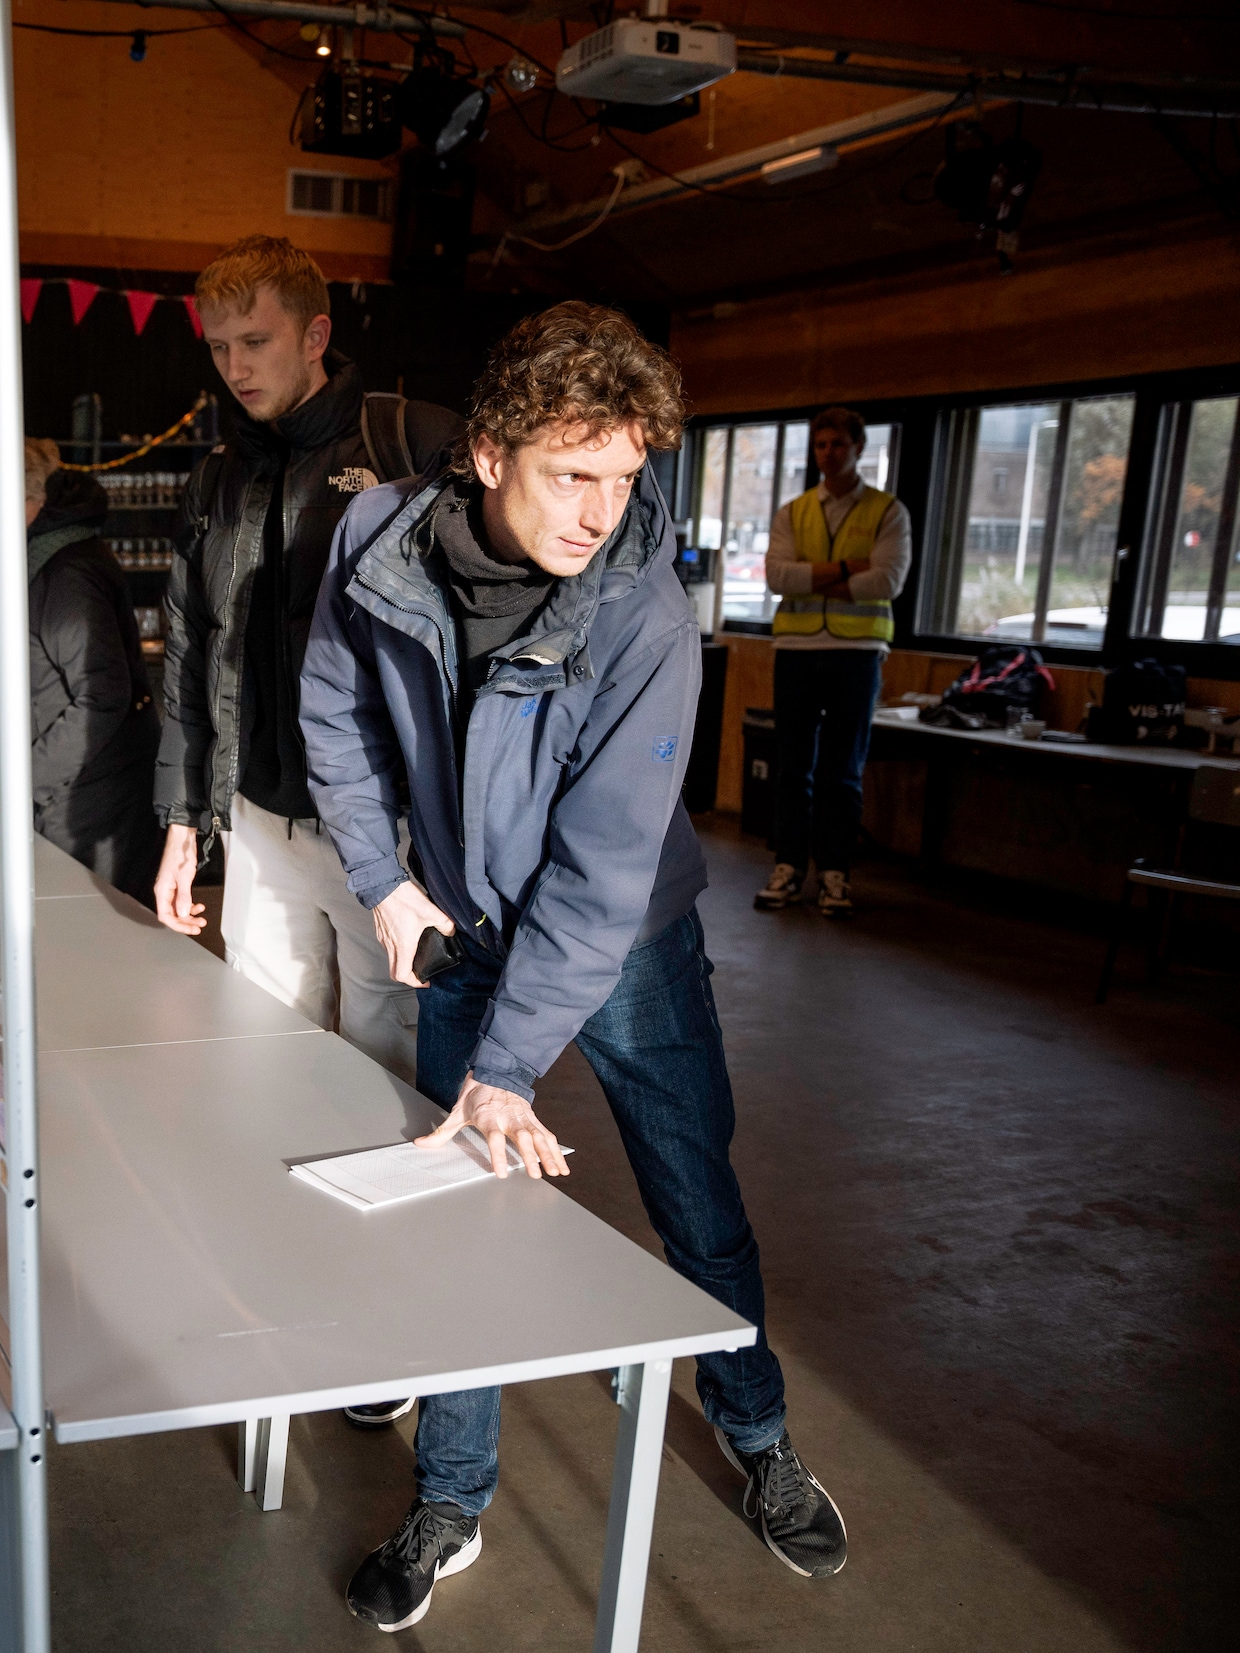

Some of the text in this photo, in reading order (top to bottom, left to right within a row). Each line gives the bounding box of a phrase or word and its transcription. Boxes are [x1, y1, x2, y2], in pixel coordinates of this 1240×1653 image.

[343, 467, 363, 476] THE
[328, 476, 363, 485] NORTH
[339, 484, 363, 493] FACE
